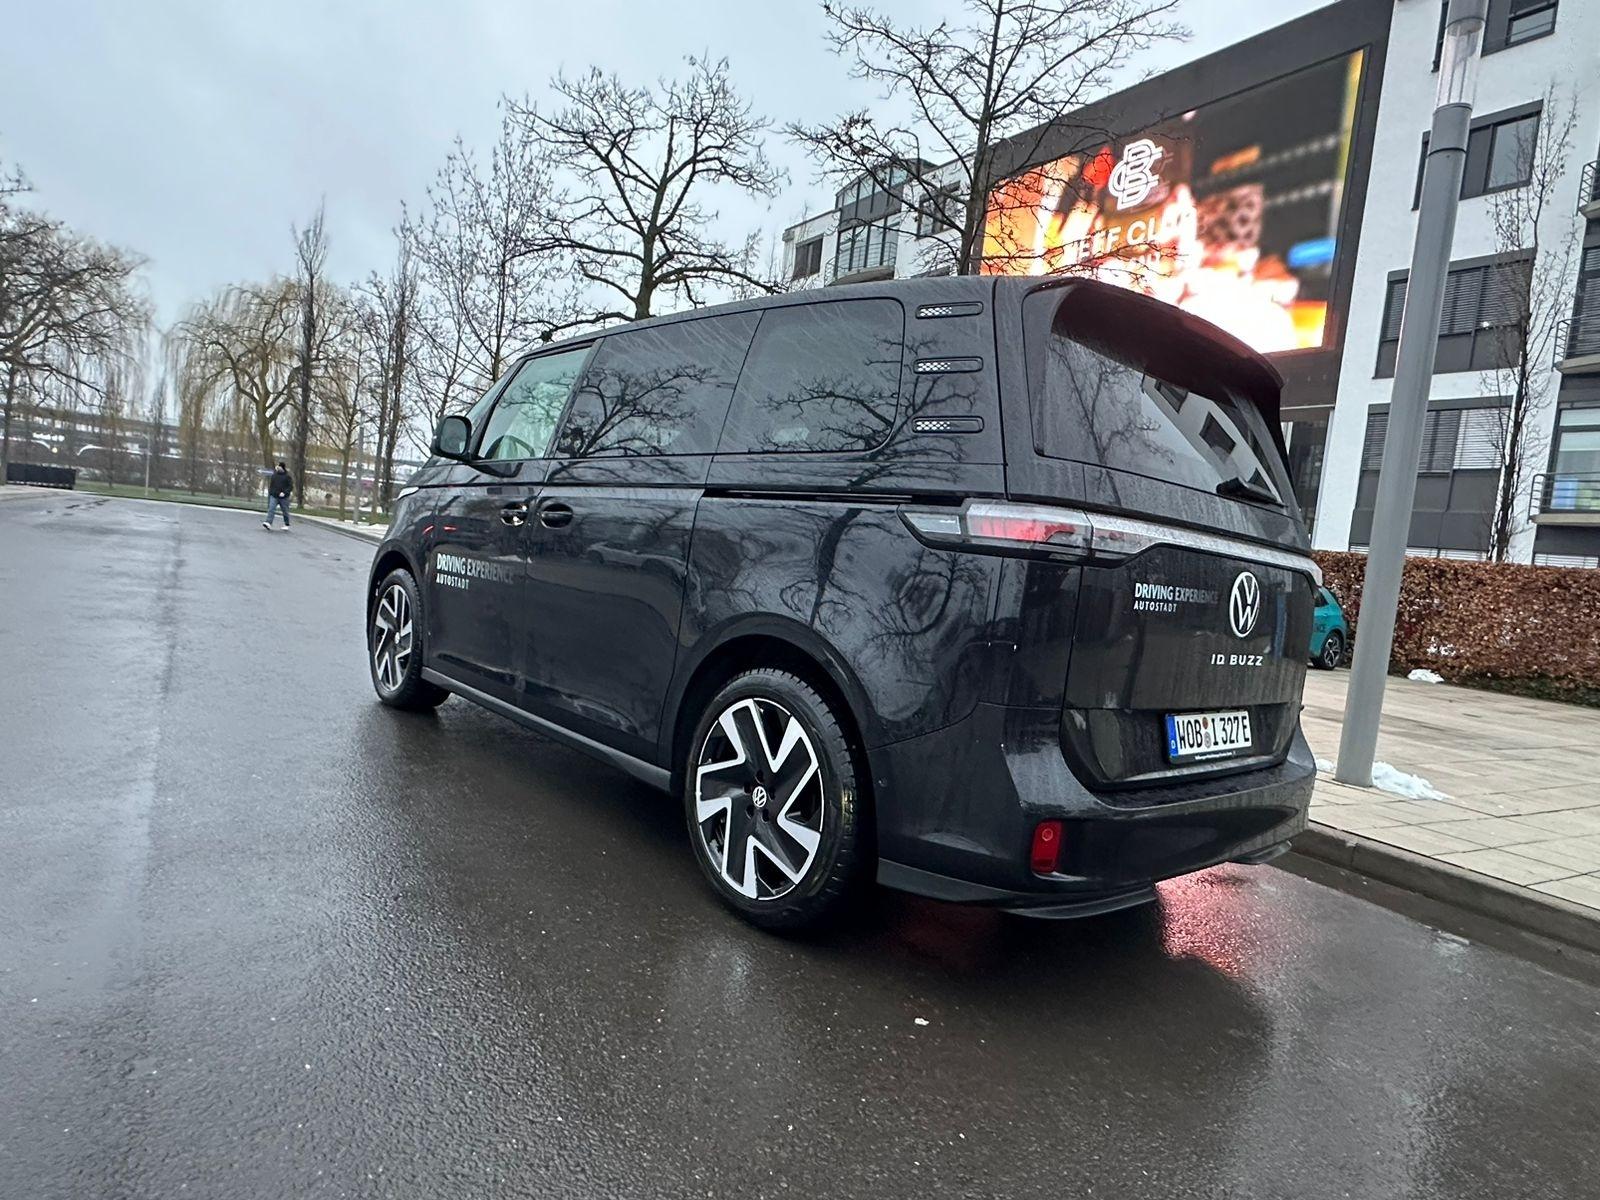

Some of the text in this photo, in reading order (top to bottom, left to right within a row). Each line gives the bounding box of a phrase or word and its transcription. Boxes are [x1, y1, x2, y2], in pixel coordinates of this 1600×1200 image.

[436, 553, 466, 574] DRIVING
[435, 573, 470, 590] AUTOSTADT
[1134, 582, 1174, 601] DRIVING
[1133, 600, 1177, 613] AUTOSTADT
[1229, 654, 1264, 666] BUZZ
[1176, 719, 1203, 750] WOB
